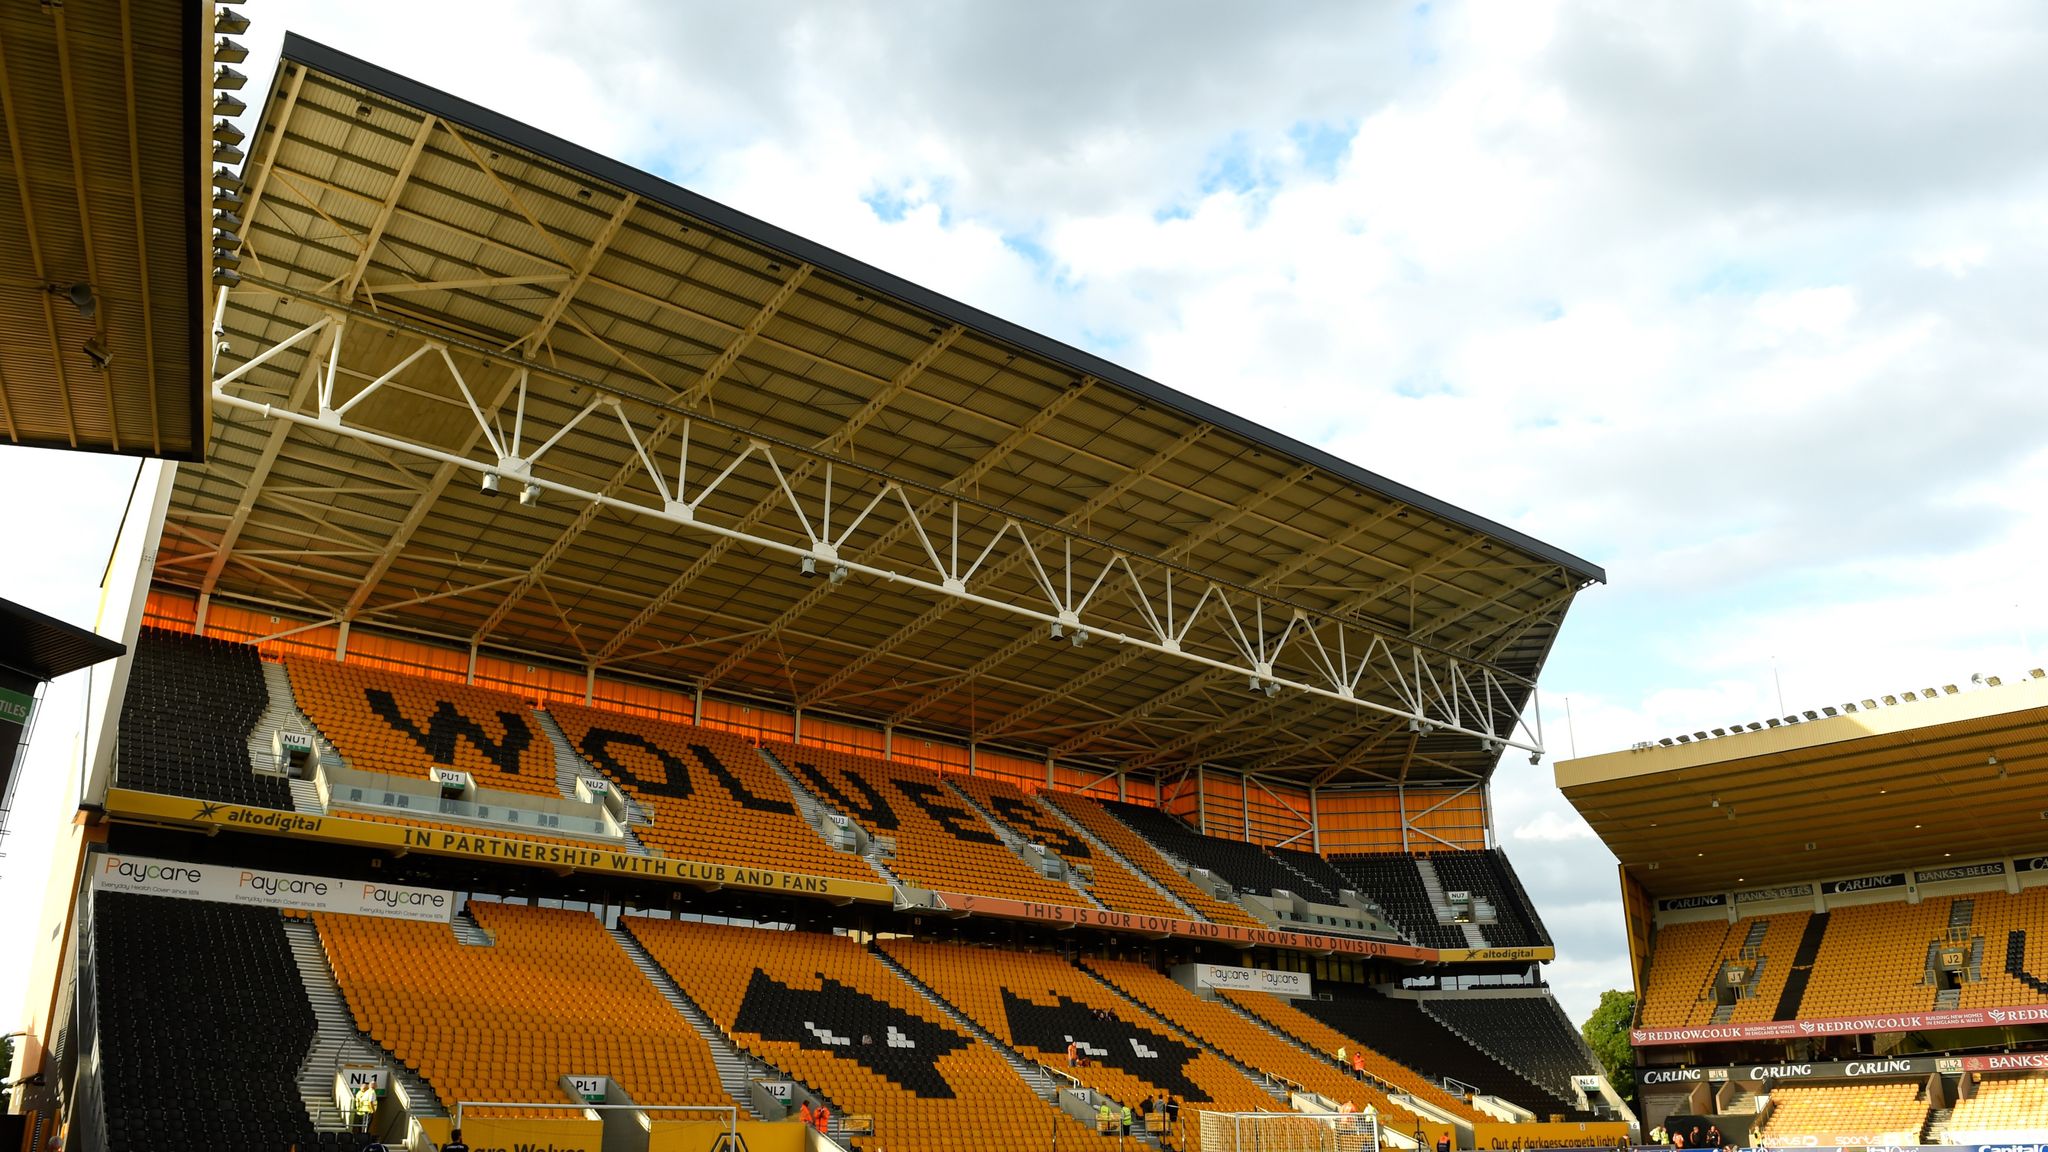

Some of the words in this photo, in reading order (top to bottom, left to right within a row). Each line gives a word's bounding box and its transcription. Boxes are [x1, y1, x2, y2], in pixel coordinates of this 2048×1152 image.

[284, 734, 306, 745] NU1
[364, 688, 1091, 859] WOLVES
[441, 772, 460, 782] PU1
[586, 780, 604, 790] NU2
[228, 809, 322, 832] altodigital
[403, 829, 432, 847] IN
[443, 835, 601, 867] PARTNERSHIP
[611, 855, 667, 875] WITH
[676, 863, 725, 881] CLUB
[735, 869, 774, 886] AND
[783, 875, 828, 893] FANS
[105, 857, 202, 883] Paycare
[1966, 864, 2002, 877] BEERS
[240, 871, 328, 896] Paycare
[1779, 885, 1811, 898] BEERS
[1834, 874, 1892, 894] CARLING
[363, 884, 445, 907] Paycare
[1666, 894, 1718, 911] CARLING
[1024, 903, 1062, 920] THIS
[1073, 908, 1087, 923] IS
[1097, 911, 1130, 927] OUR
[1140, 916, 1177, 932] LOVE
[1189, 923, 1219, 937] AND
[1227, 926, 1239, 939] IT
[1248, 929, 1297, 946] KNOWS
[1304, 935, 1323, 948] NO
[1330, 938, 1387, 955] DIVISION
[1482, 949, 1534, 960] altodigital
[1947, 954, 1959, 964] J2
[1209, 966, 1249, 982] Paycare
[1261, 970, 1299, 986] Paycare
[1817, 1016, 1922, 1033] REDROW.CO.UK
[1648, 1027, 1741, 1041] REDROW.CO.UK
[1750, 1064, 1812, 1081] CARLING
[1845, 1059, 1911, 1076] CARLING
[350, 1073, 378, 1085] NL1
[1580, 1078, 1595, 1086] NL6
[1643, 1069, 1701, 1085] CARLING
[576, 1080, 597, 1091] PL1
